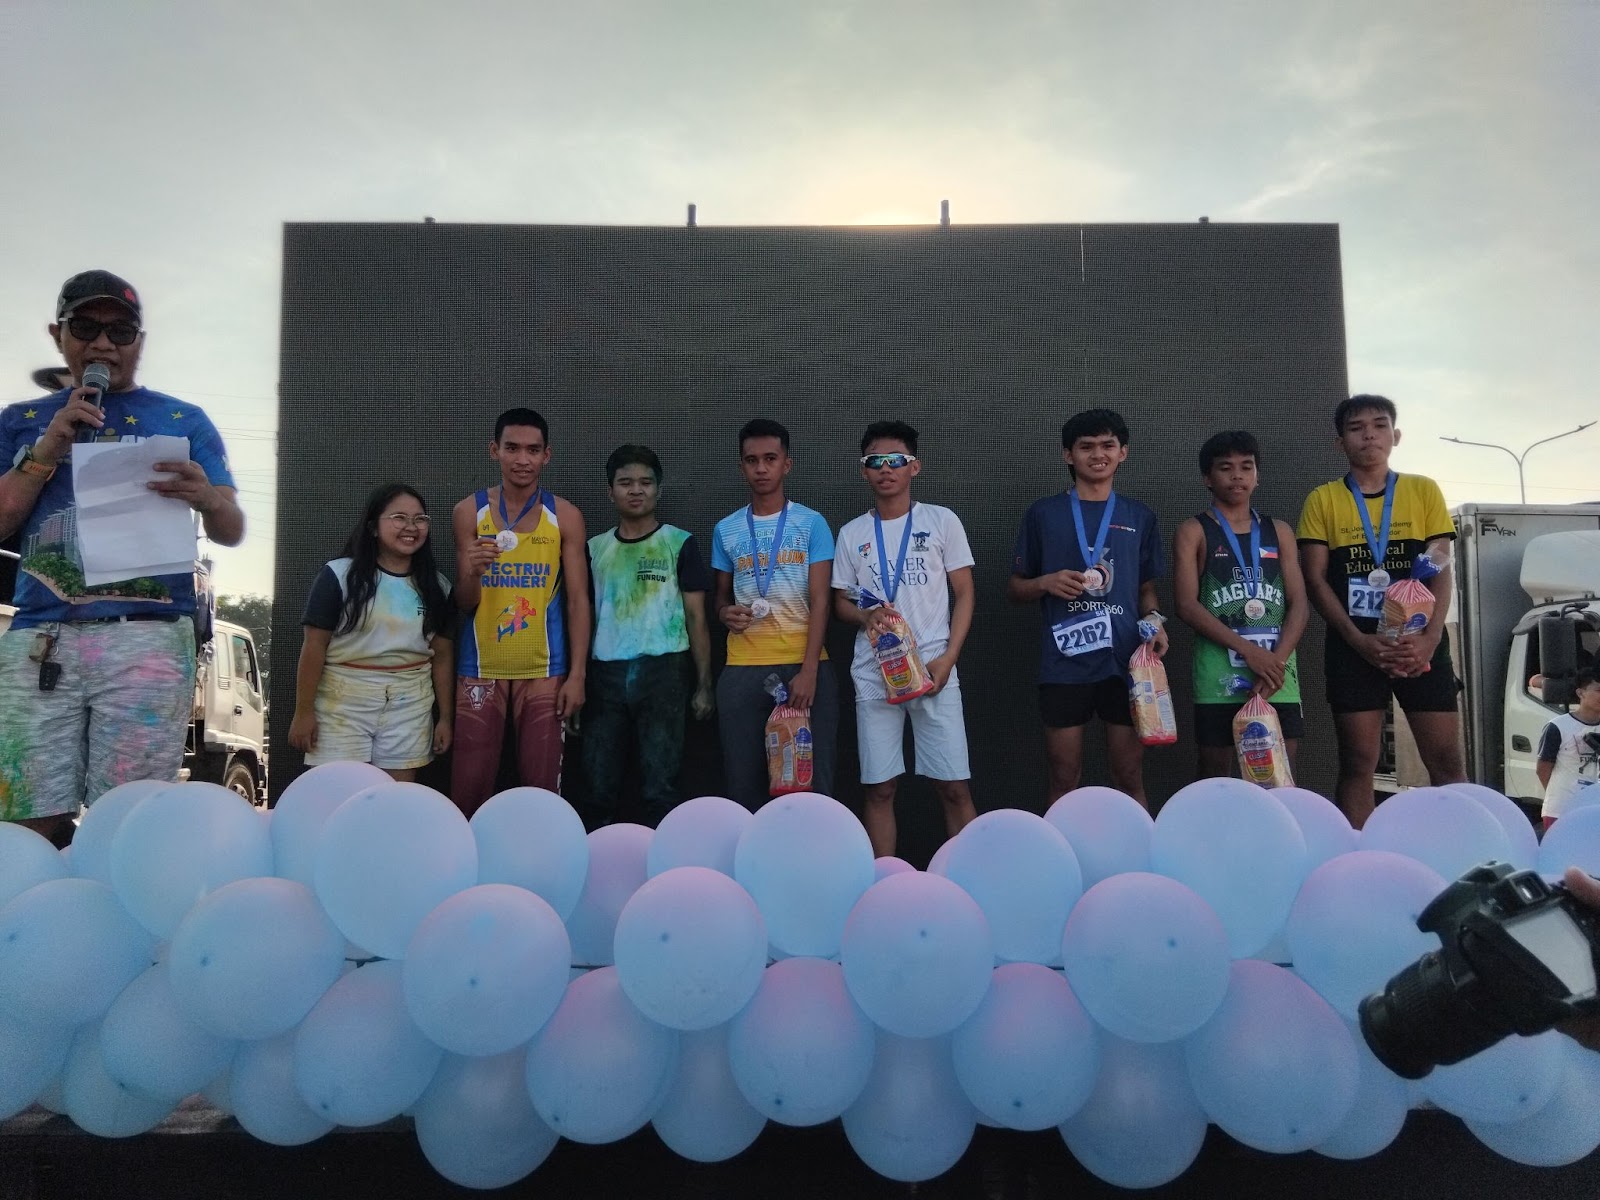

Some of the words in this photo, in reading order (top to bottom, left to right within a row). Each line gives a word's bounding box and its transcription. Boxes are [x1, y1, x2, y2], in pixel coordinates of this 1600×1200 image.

[1350, 543, 1405, 559] Phycal
[1352, 589, 1386, 609] 212
[1056, 621, 1111, 651] 2262
